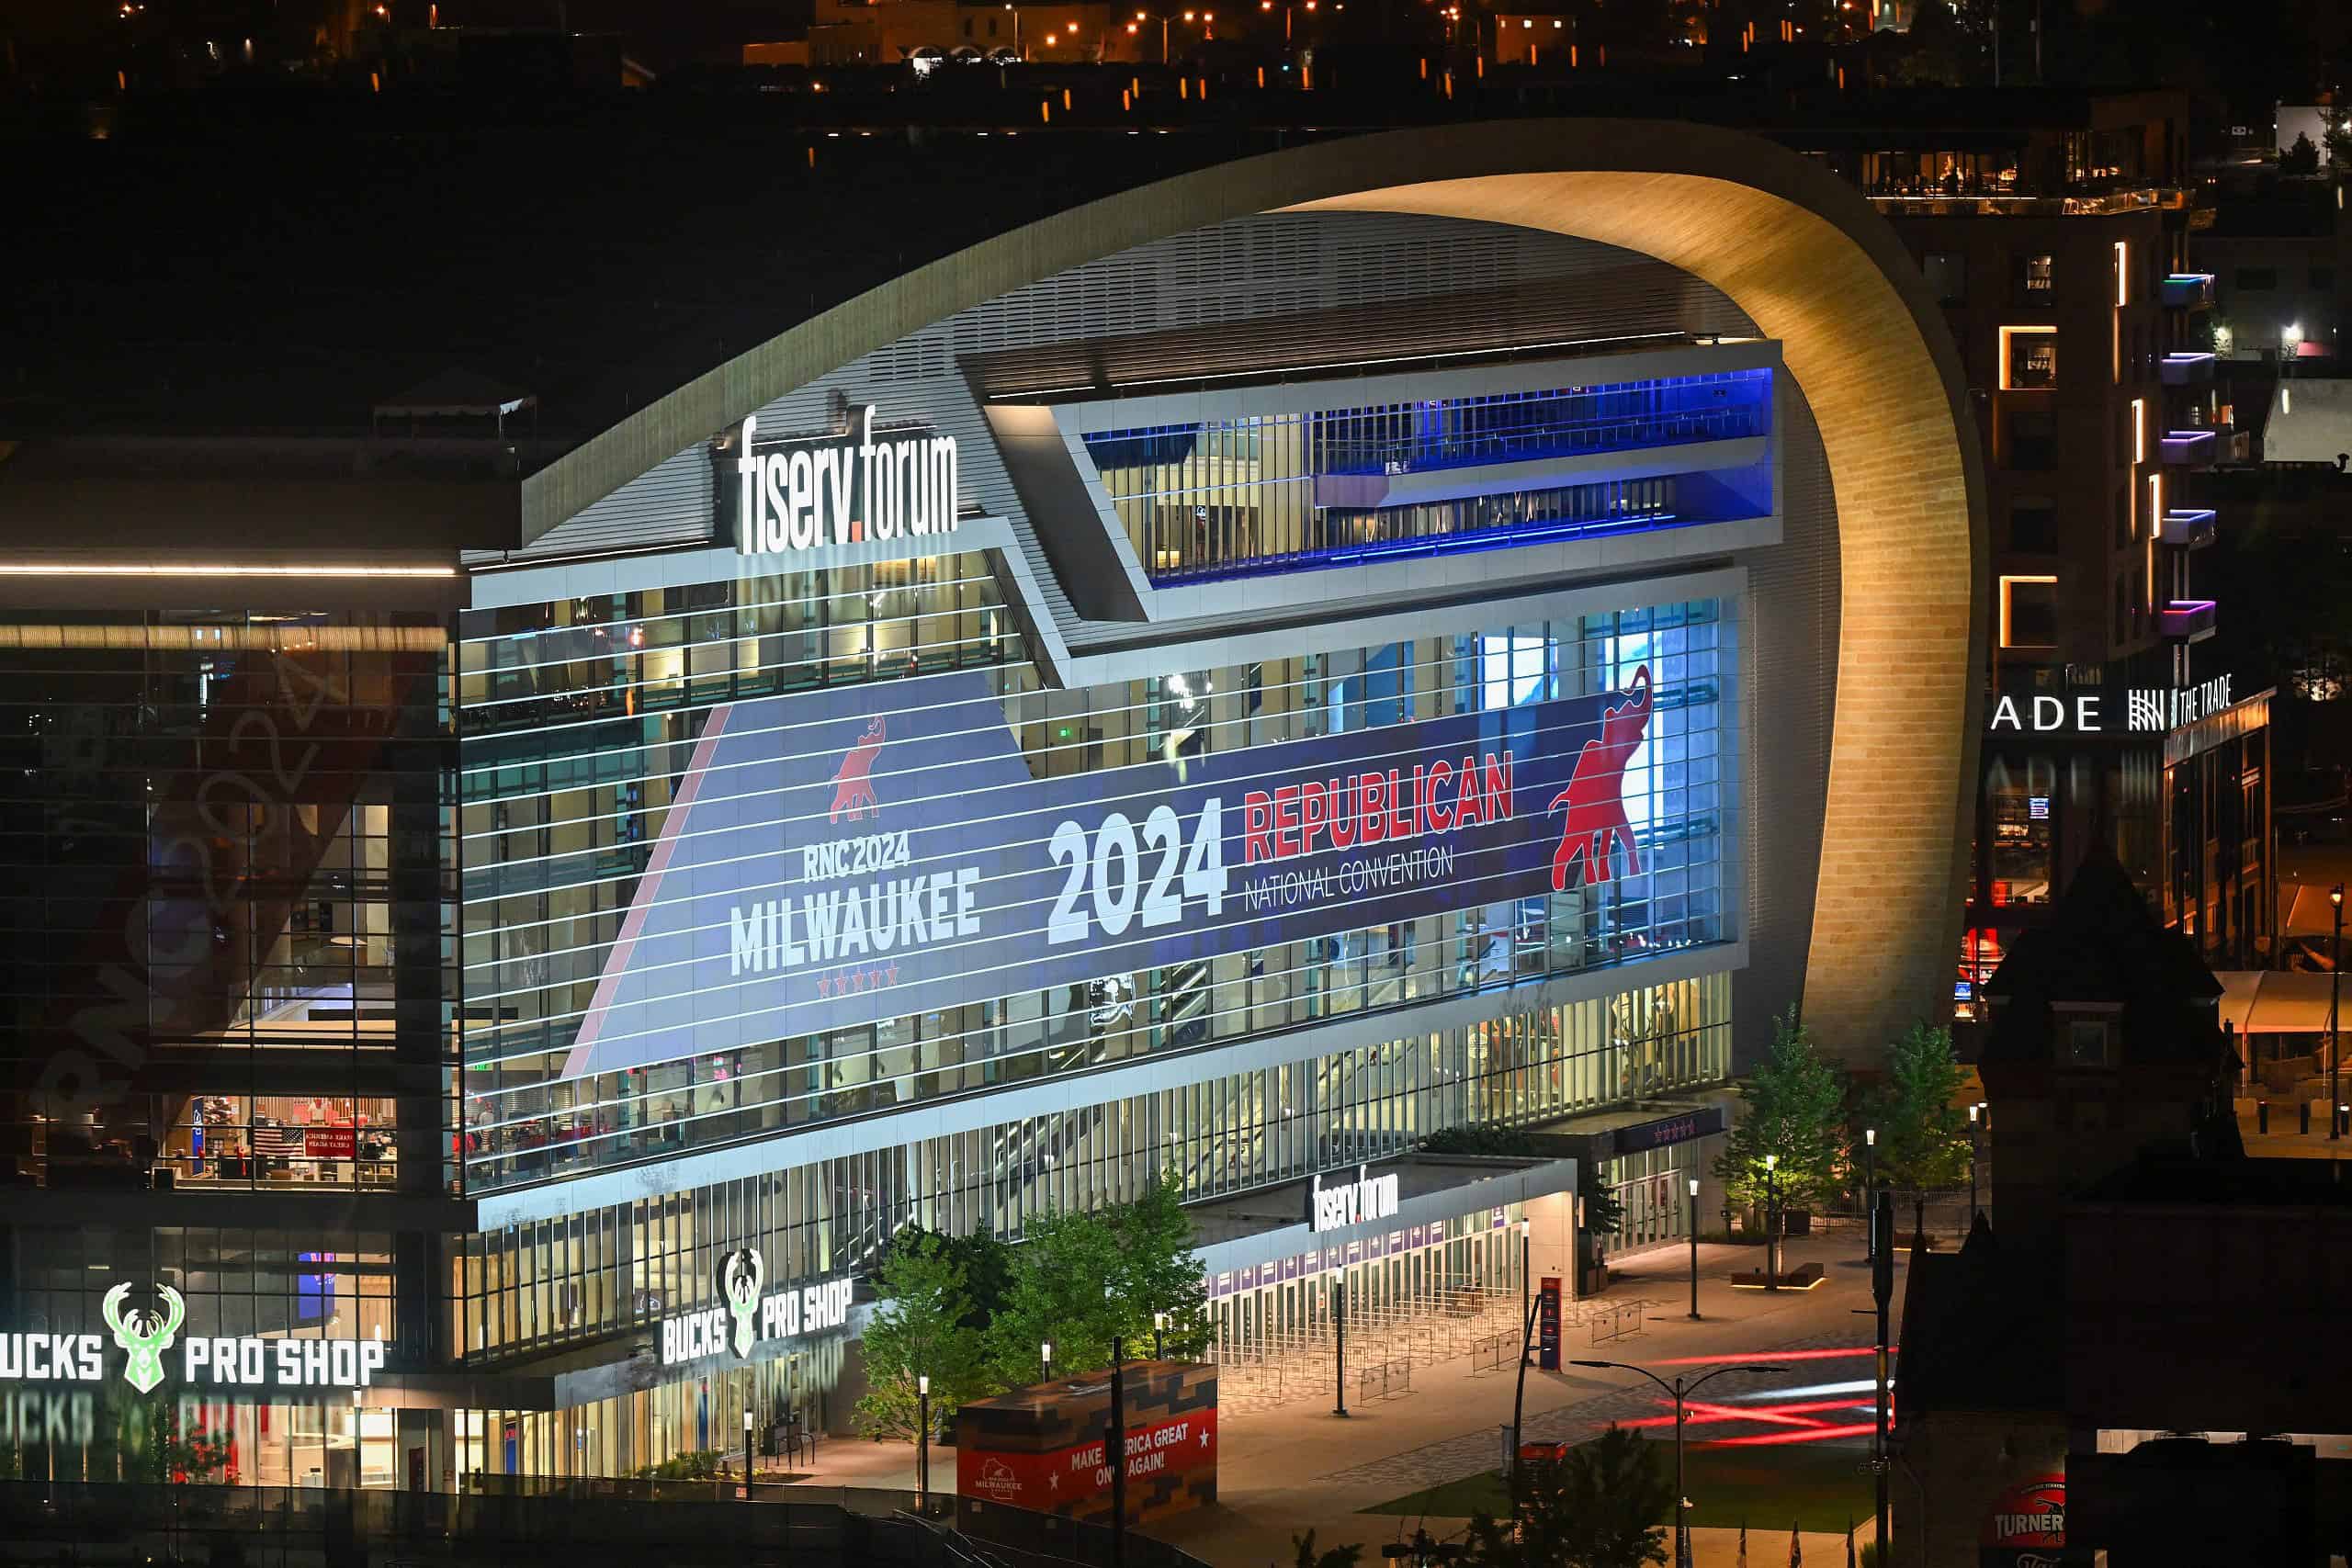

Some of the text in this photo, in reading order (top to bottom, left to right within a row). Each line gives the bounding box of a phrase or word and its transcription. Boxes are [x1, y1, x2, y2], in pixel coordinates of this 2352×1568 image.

[2180, 673, 2232, 726] THE TRADE
[1244, 750, 1514, 866] REPUBLICAN
[1047, 797, 1228, 945] 2024
[1244, 845, 1454, 912] NATIONAL CONVENTION
[730, 866, 980, 980] MILWAUKEE
[662, 1278, 853, 1365] BUCKS PRO SHOP
[186, 1337, 265, 1384] PRO
[277, 1339, 384, 1386] SHOP
[1071, 1447, 1102, 1471] MAKE
[1154, 1422, 1189, 1448] GREAT
[1127, 1451, 1165, 1477] AGAIN!
[1994, 1514, 2064, 1540] TURNER
